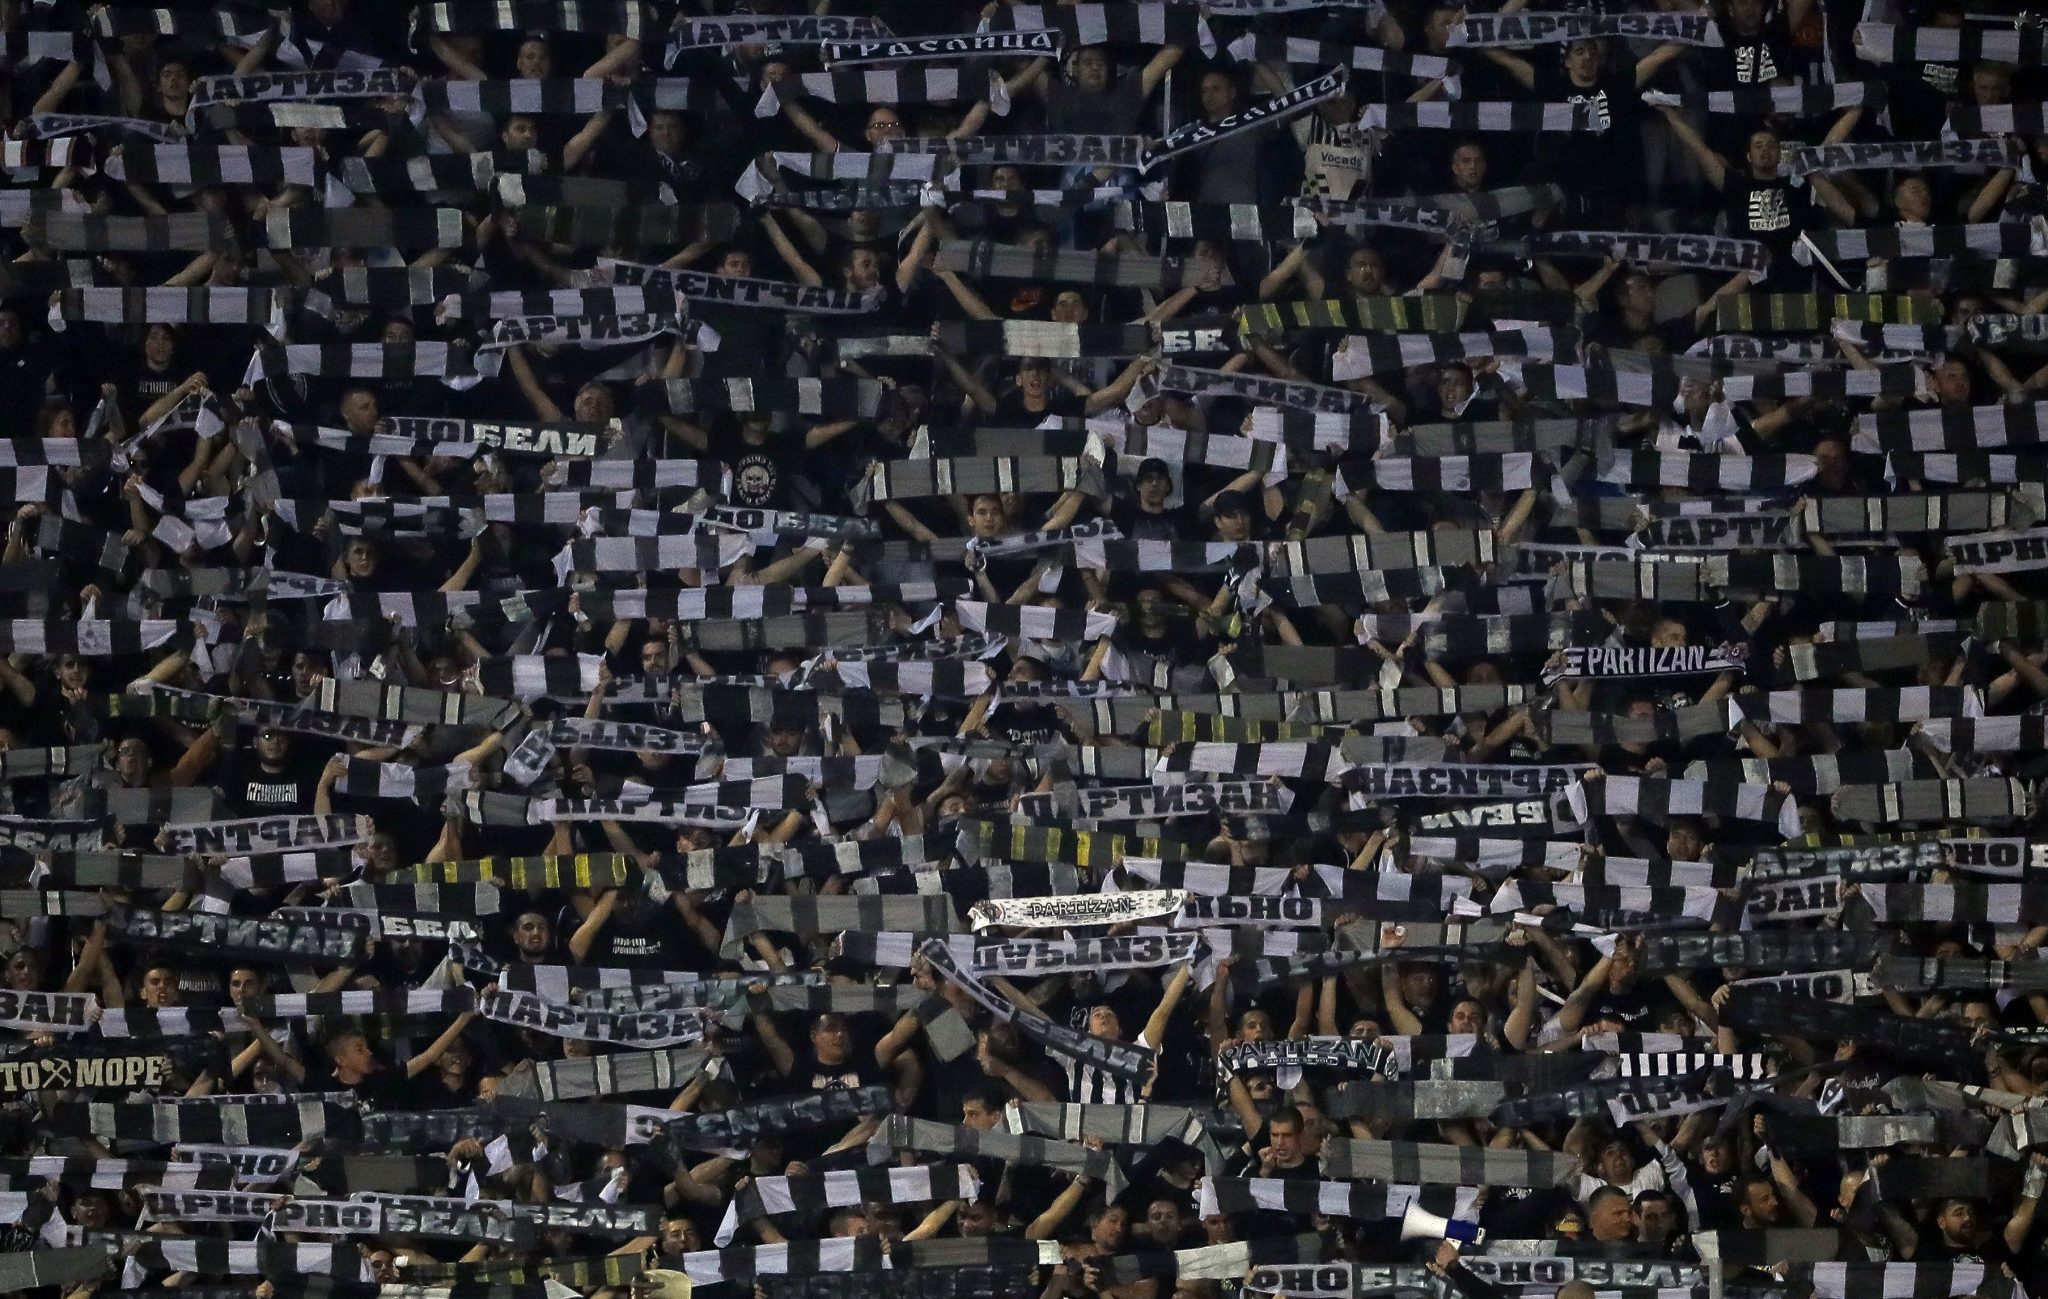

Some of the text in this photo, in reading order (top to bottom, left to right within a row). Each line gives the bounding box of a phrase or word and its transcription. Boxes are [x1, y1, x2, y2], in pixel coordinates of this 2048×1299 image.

[1466, 14, 1707, 44] ПАРТИЗАН
[473, 423, 597, 457] БЕЛИ
[1022, 782, 1280, 822] ПРТИЗАН
[1032, 898, 1137, 919] PARTIZAN
